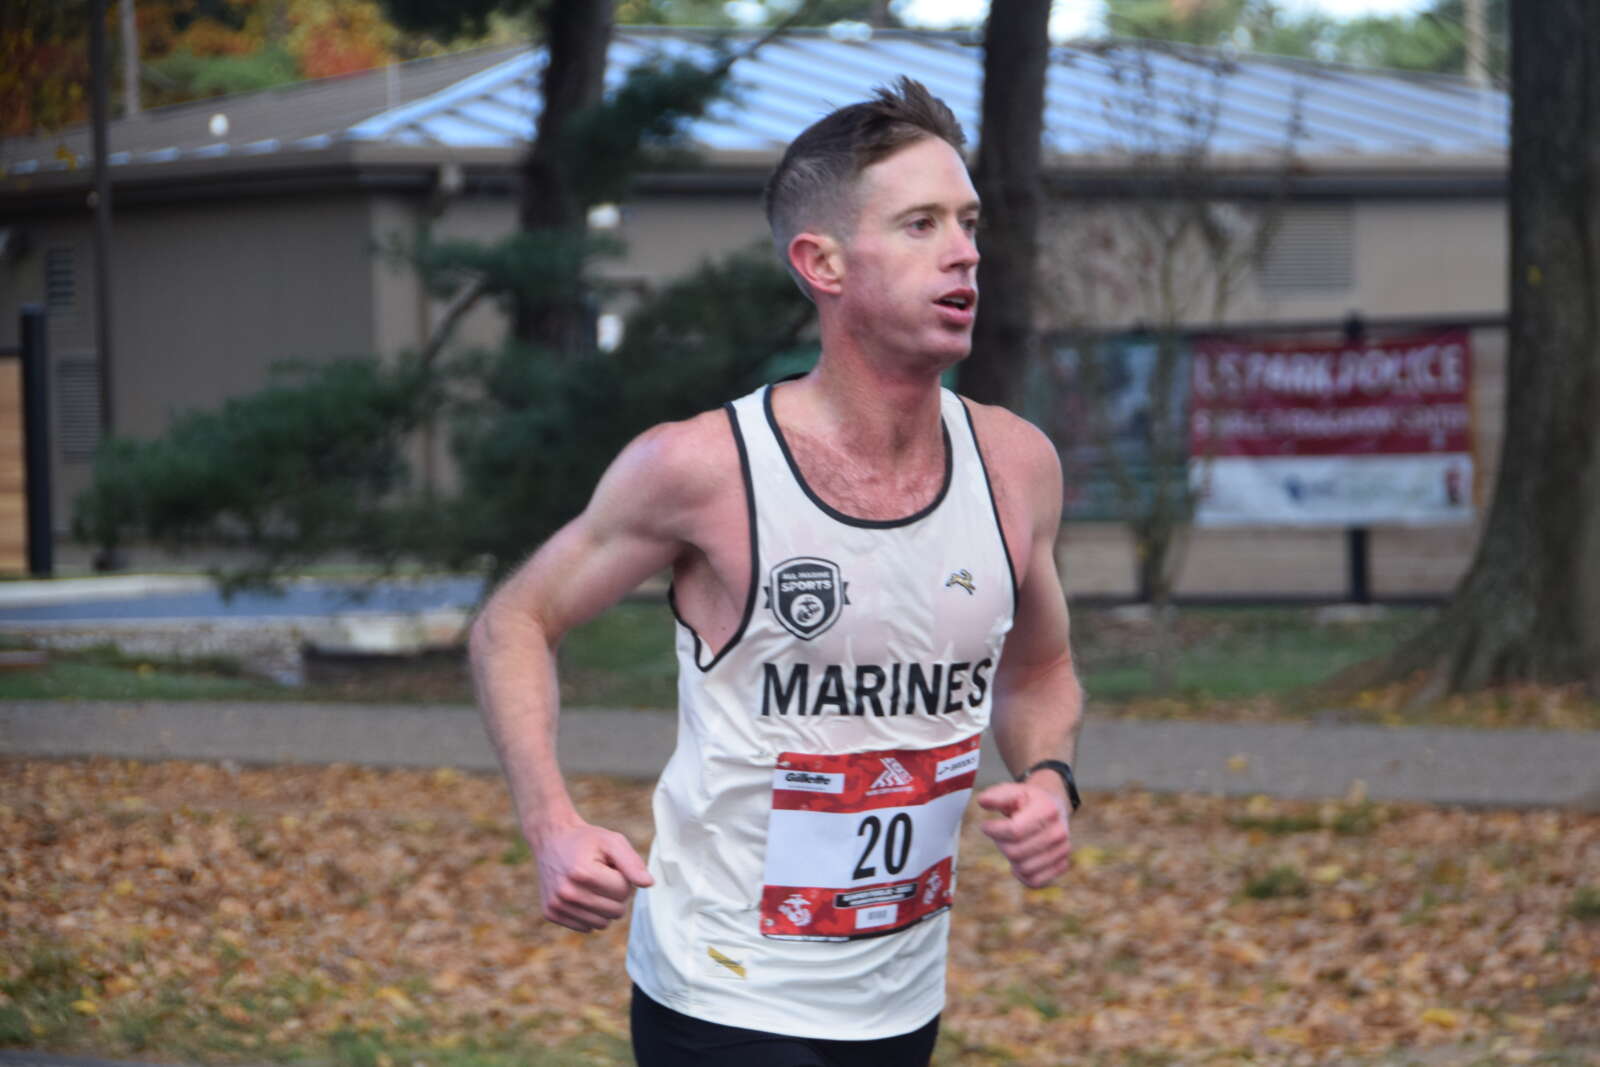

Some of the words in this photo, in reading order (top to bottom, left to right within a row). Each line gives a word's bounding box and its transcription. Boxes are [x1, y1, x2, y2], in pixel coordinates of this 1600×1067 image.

[781, 580, 832, 592] SPORTS
[761, 658, 992, 716] MARINES
[785, 772, 831, 785] Gillette
[852, 812, 913, 880] 20
